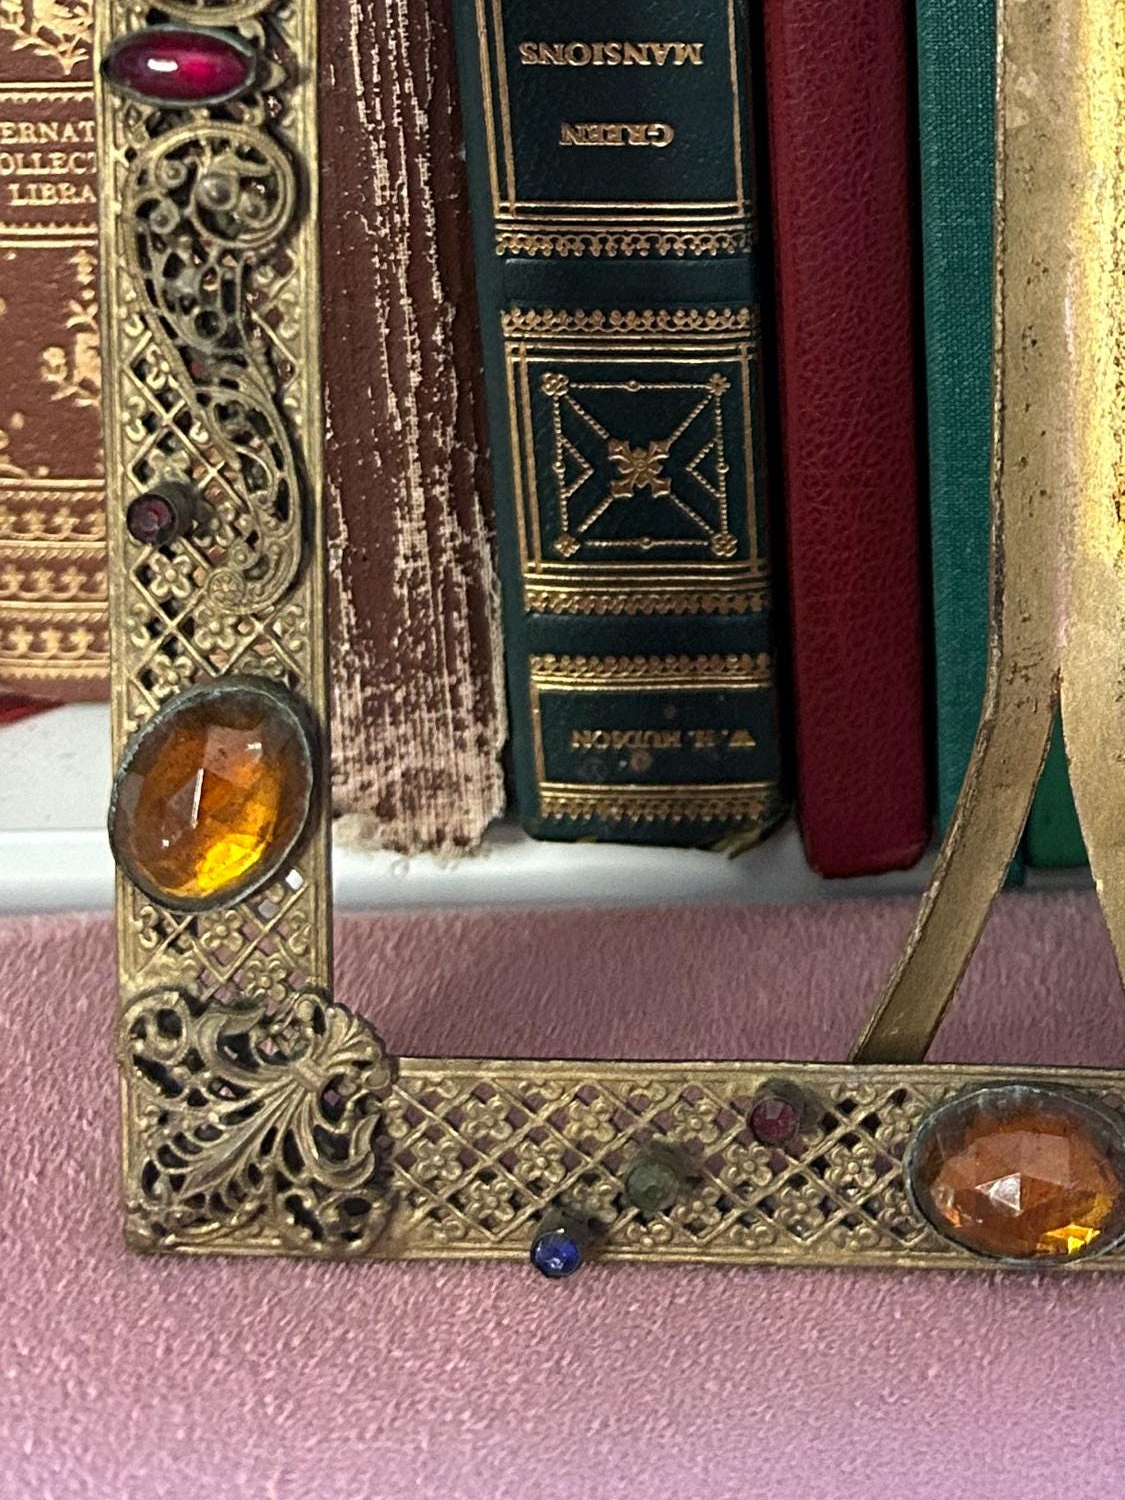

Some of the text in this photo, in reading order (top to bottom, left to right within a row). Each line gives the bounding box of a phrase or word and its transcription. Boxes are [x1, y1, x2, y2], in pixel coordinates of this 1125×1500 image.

[518, 41, 704, 67] MANSIONS
[559, 123, 675, 147] GREEN
[8, 182, 97, 207] LIBRA
[570, 727, 683, 750] HUDSON
